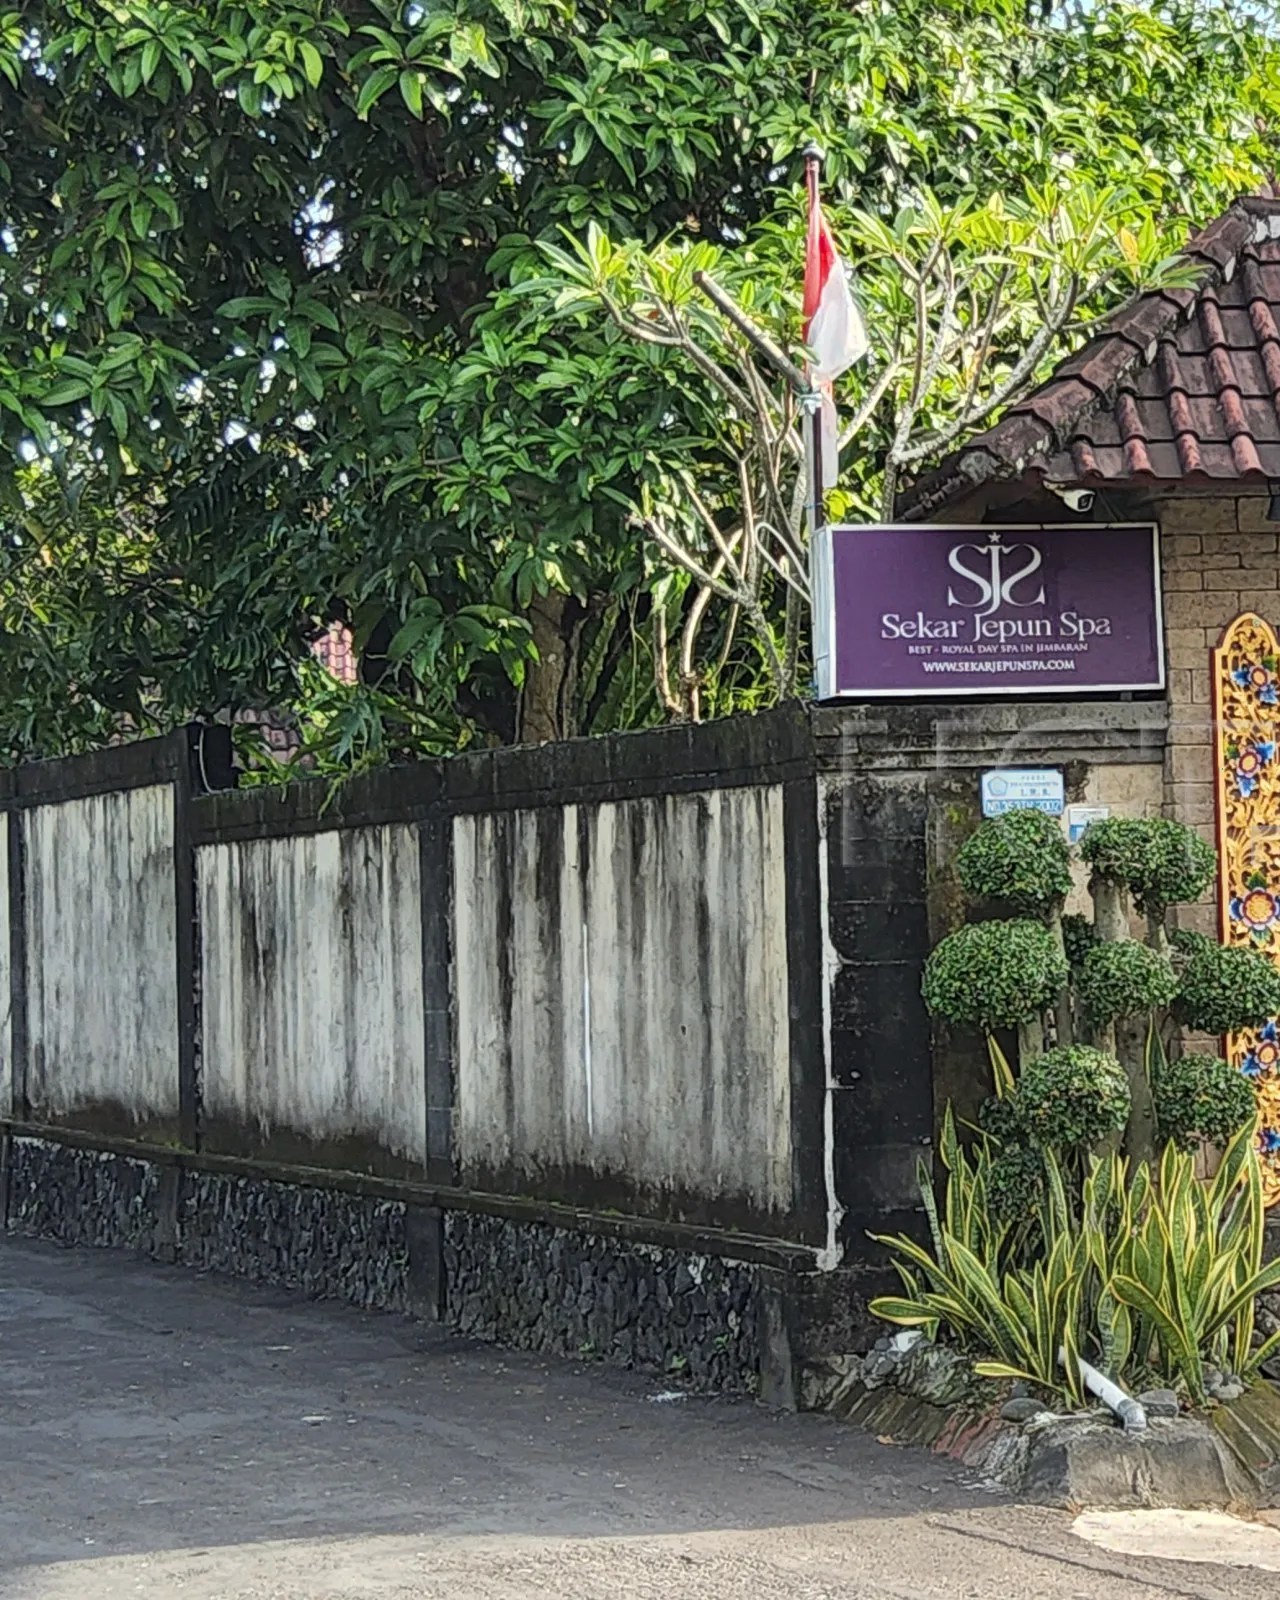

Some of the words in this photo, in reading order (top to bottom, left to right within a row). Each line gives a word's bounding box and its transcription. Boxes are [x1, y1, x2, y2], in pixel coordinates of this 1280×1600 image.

[881, 611, 965, 639] Sekar
[972, 613, 1052, 643] Jepun
[1060, 611, 1111, 641] Spa
[908, 645, 933, 655] BEST
[941, 644, 975, 655] ROYAL
[977, 644, 999, 654] DAY
[1000, 643, 1019, 653] SPA
[1020, 643, 1034, 653] IN
[1036, 642, 1089, 654] JIMBARAN
[922, 659, 1076, 674] WWW.SEKARJEPUNSPA.COM
